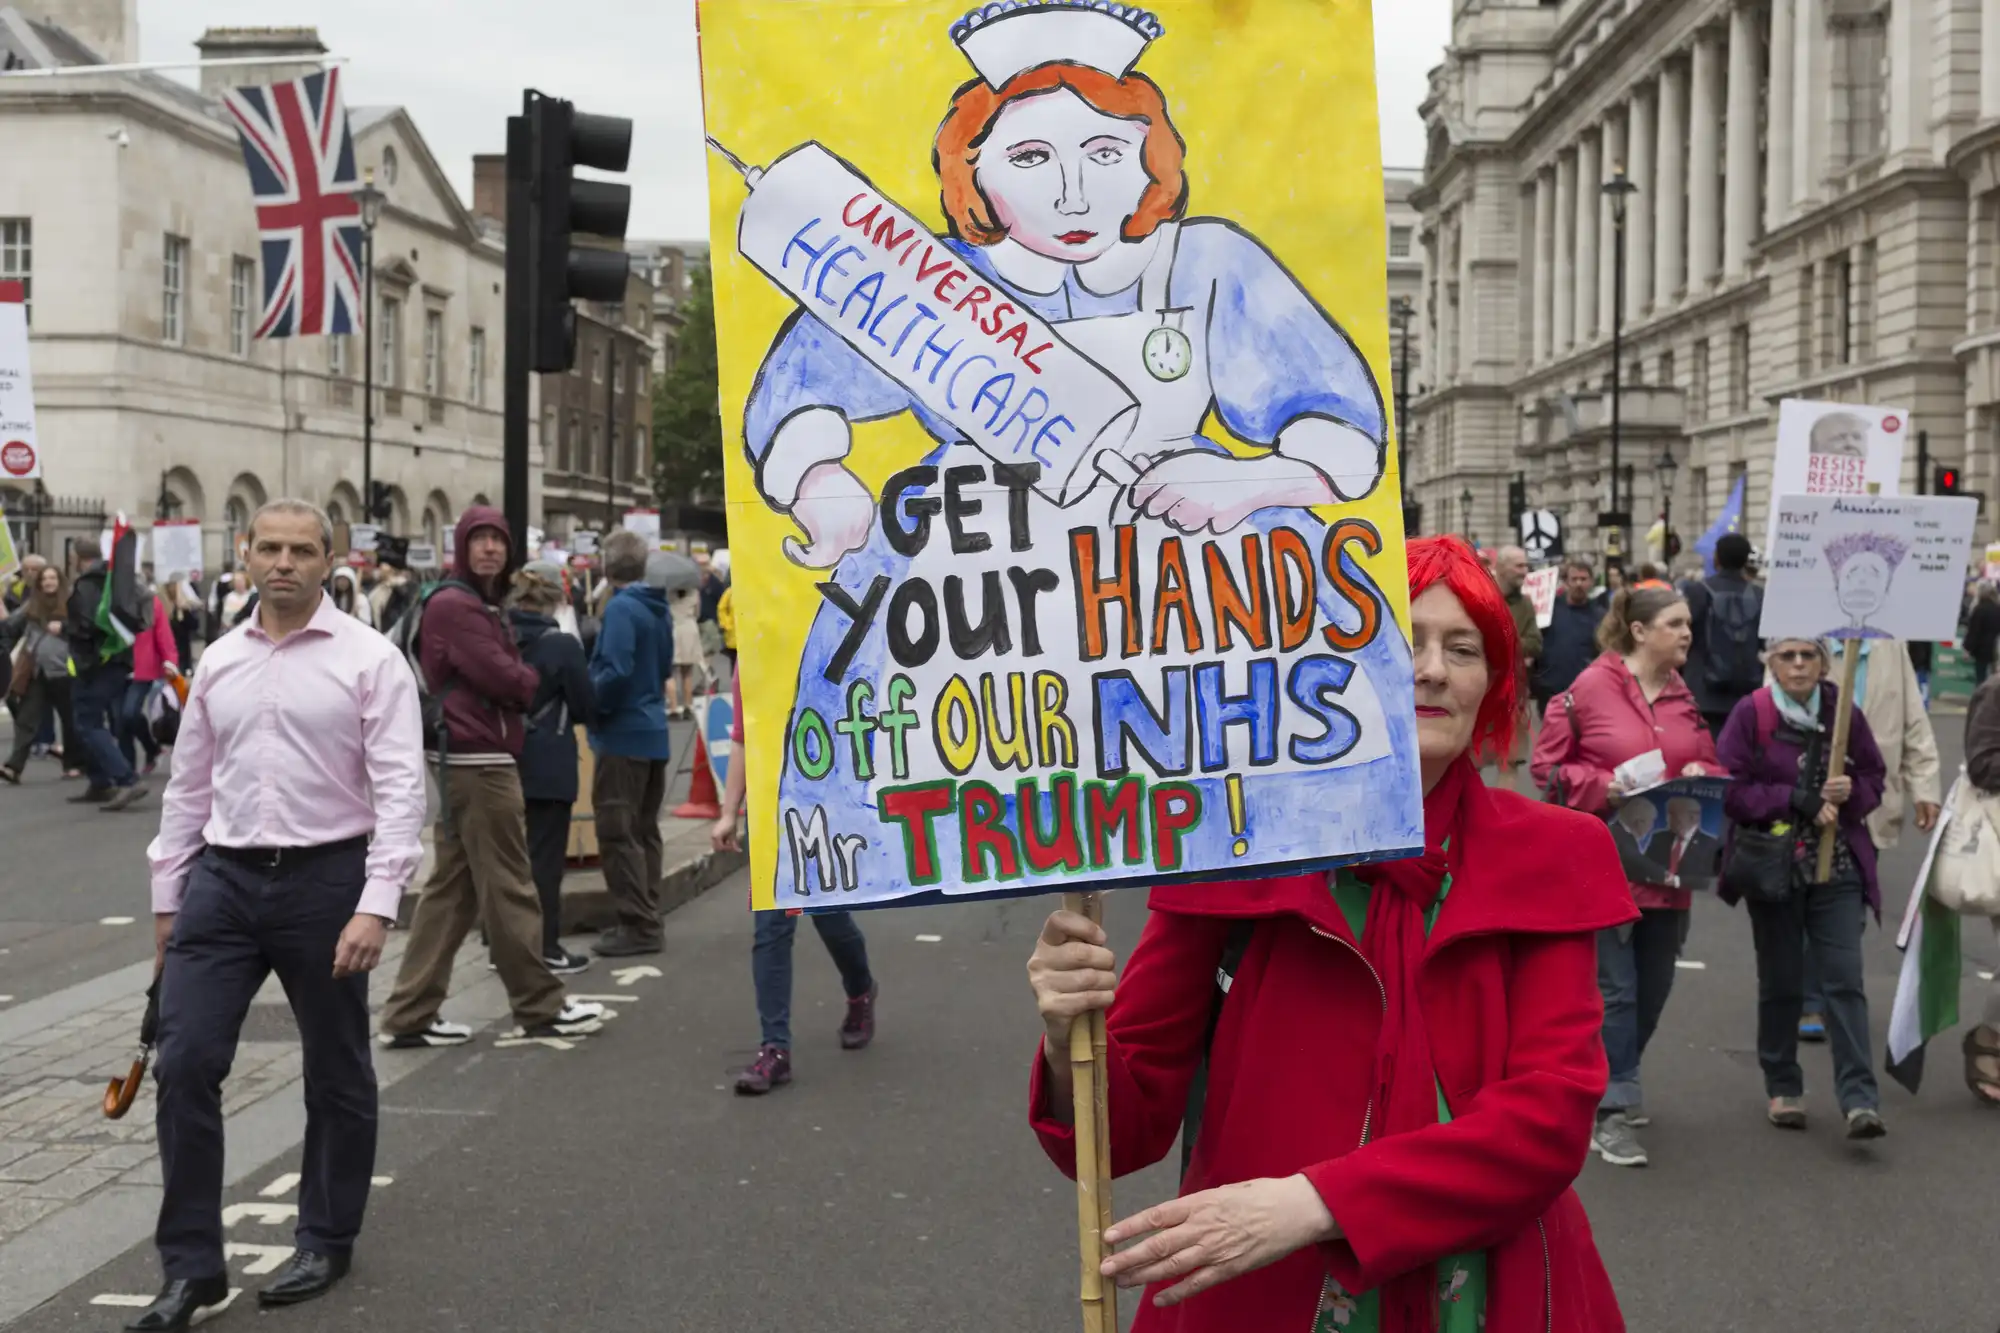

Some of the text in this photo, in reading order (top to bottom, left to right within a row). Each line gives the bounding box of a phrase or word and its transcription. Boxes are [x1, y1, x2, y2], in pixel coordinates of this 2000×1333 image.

[842, 193, 1056, 375] UNIVERSAL
[781, 217, 1076, 467] HEALTHCARE
[880, 462, 1041, 557] GET
[1807, 471, 1865, 490] RESIST
[1809, 455, 1866, 474] RESIST
[1067, 518, 1384, 661] HANDS
[931, 669, 1078, 778] OUR
[1092, 652, 1362, 780] NHS
[785, 803, 867, 897] Mr
